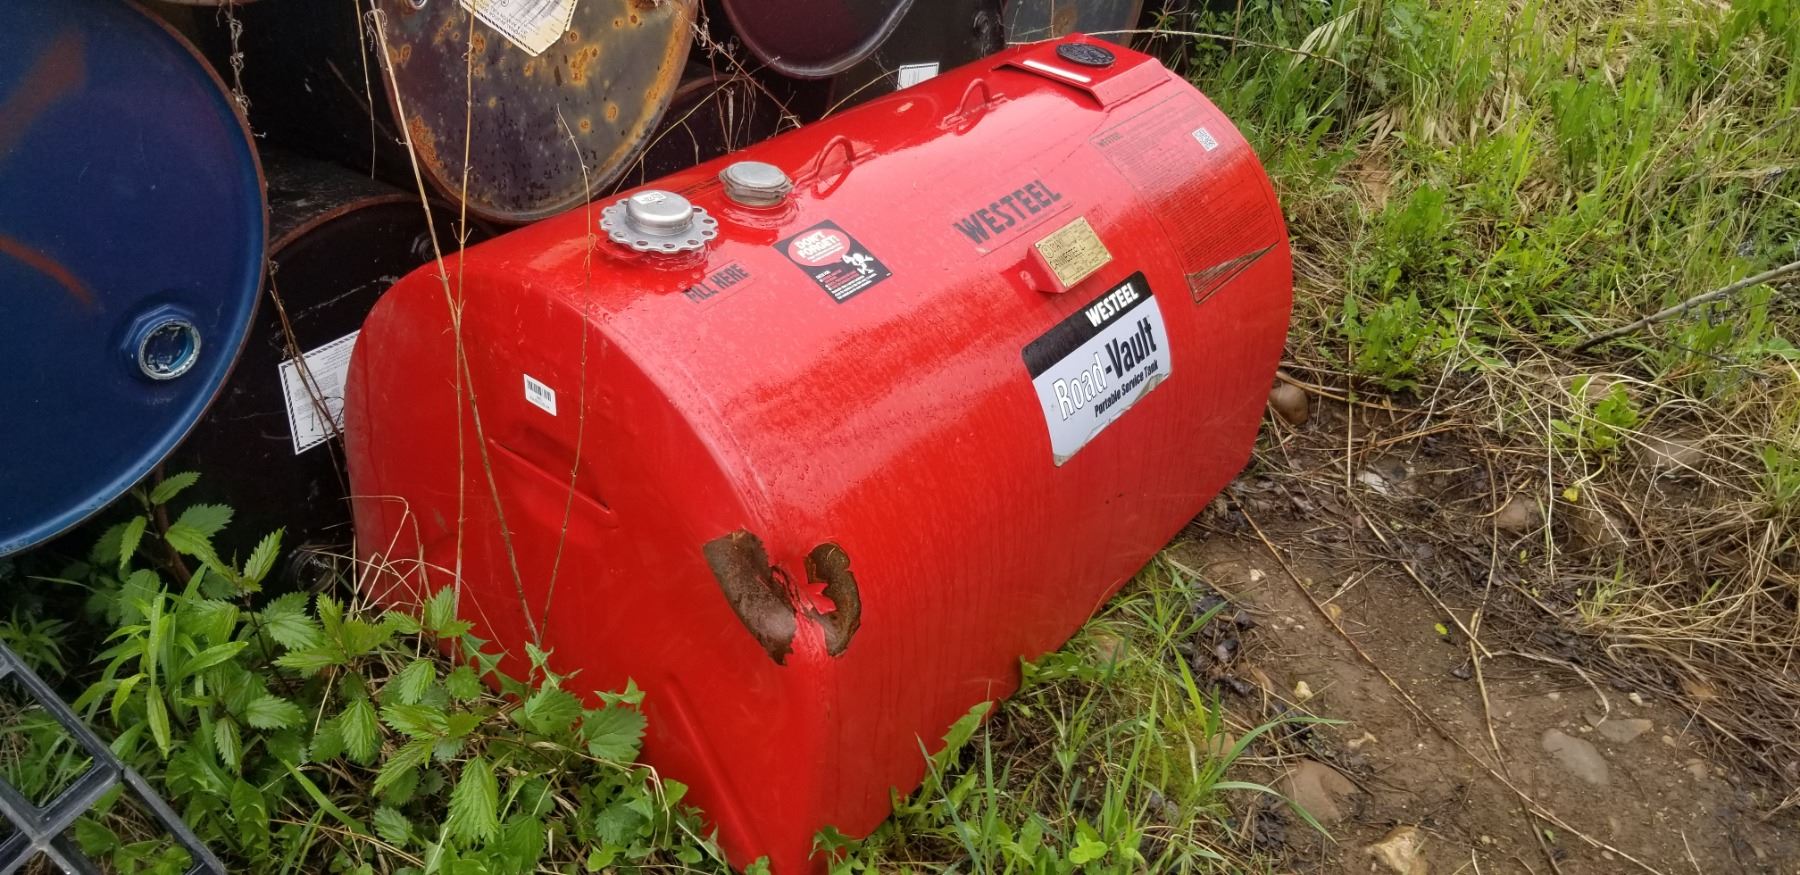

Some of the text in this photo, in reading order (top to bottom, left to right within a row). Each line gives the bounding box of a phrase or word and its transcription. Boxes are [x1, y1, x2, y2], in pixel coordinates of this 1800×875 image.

[952, 180, 1063, 245] WESTEEL
[794, 230, 827, 250] DON'T
[797, 235, 842, 259] FORGET!
[713, 263, 750, 290] HERE
[1085, 282, 1140, 329] WESTEEL
[1052, 317, 1157, 421] Road-Vault
[1094, 360, 1159, 418] Portable Service Tank
